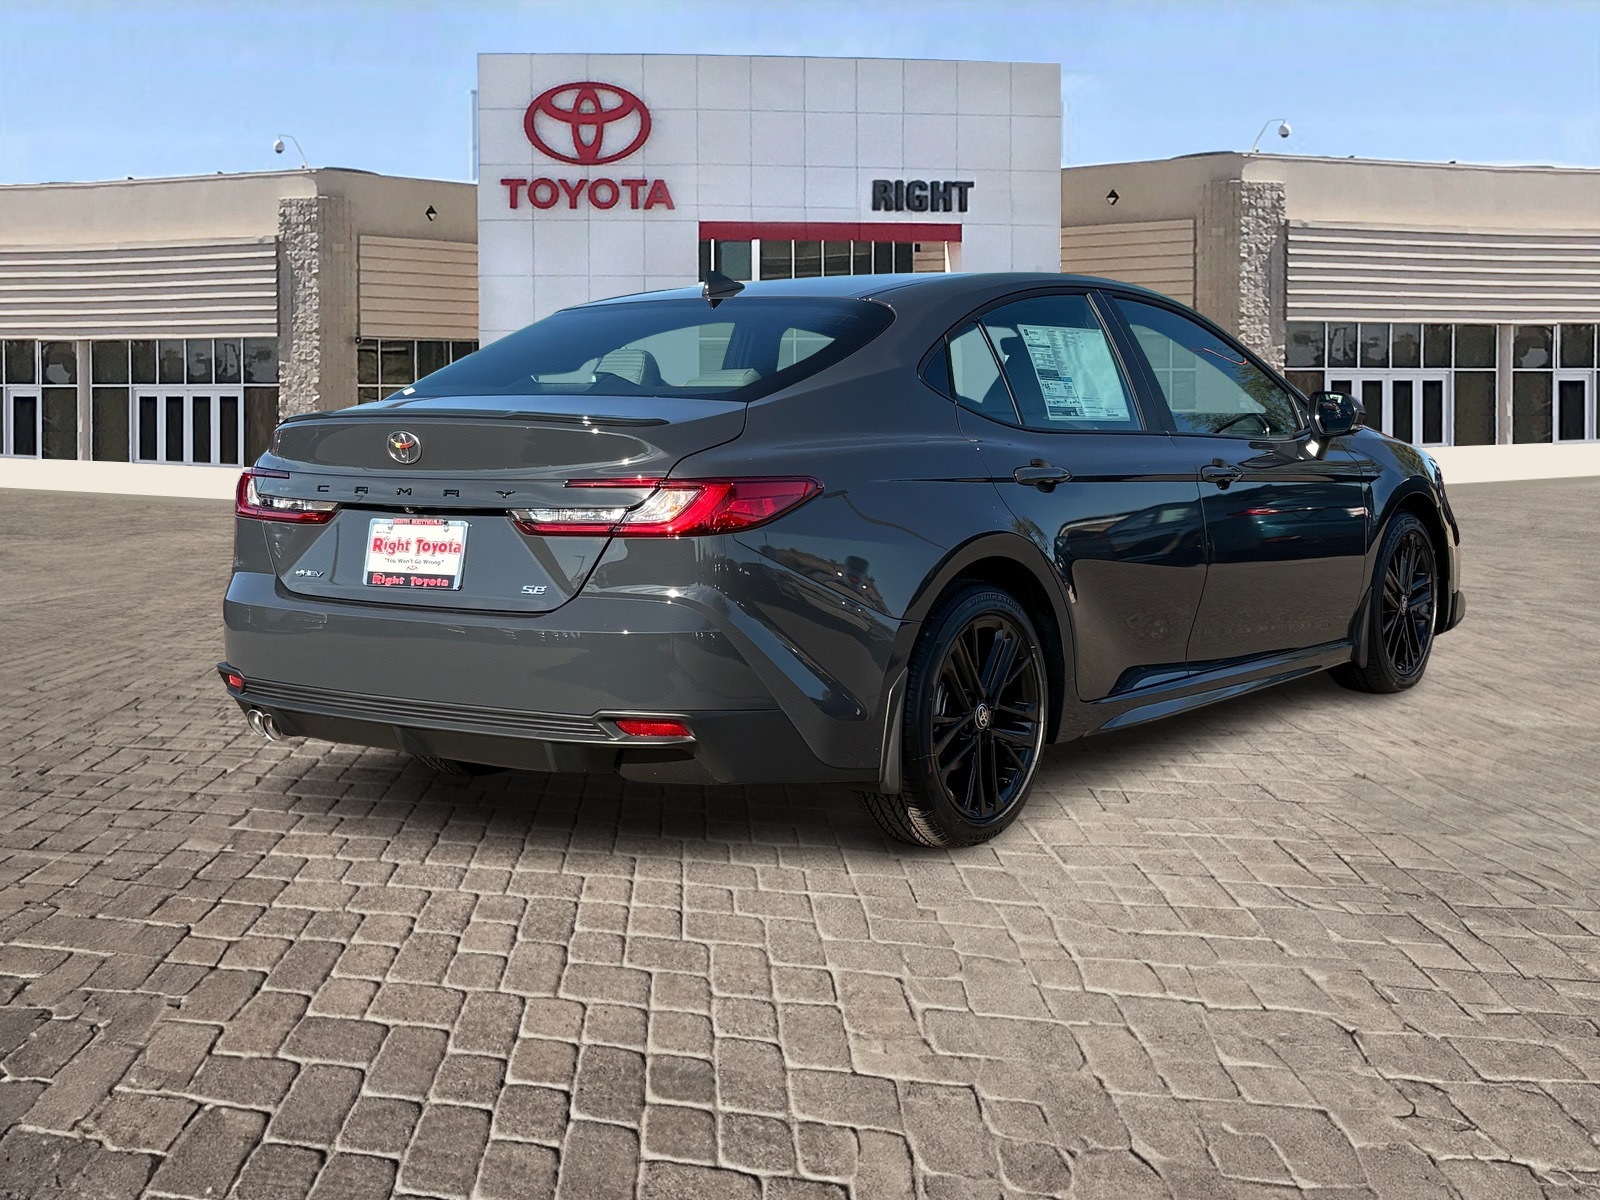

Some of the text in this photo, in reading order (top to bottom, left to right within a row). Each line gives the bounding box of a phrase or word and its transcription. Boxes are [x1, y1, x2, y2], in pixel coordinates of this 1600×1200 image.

[500, 177, 675, 210] TOYOTA
[872, 179, 975, 213] RIGHT
[317, 484, 516, 499] CAMRY
[372, 536, 462, 556] Right Toyota
[372, 573, 449, 588] Right Toyota
[521, 585, 547, 595] SE
